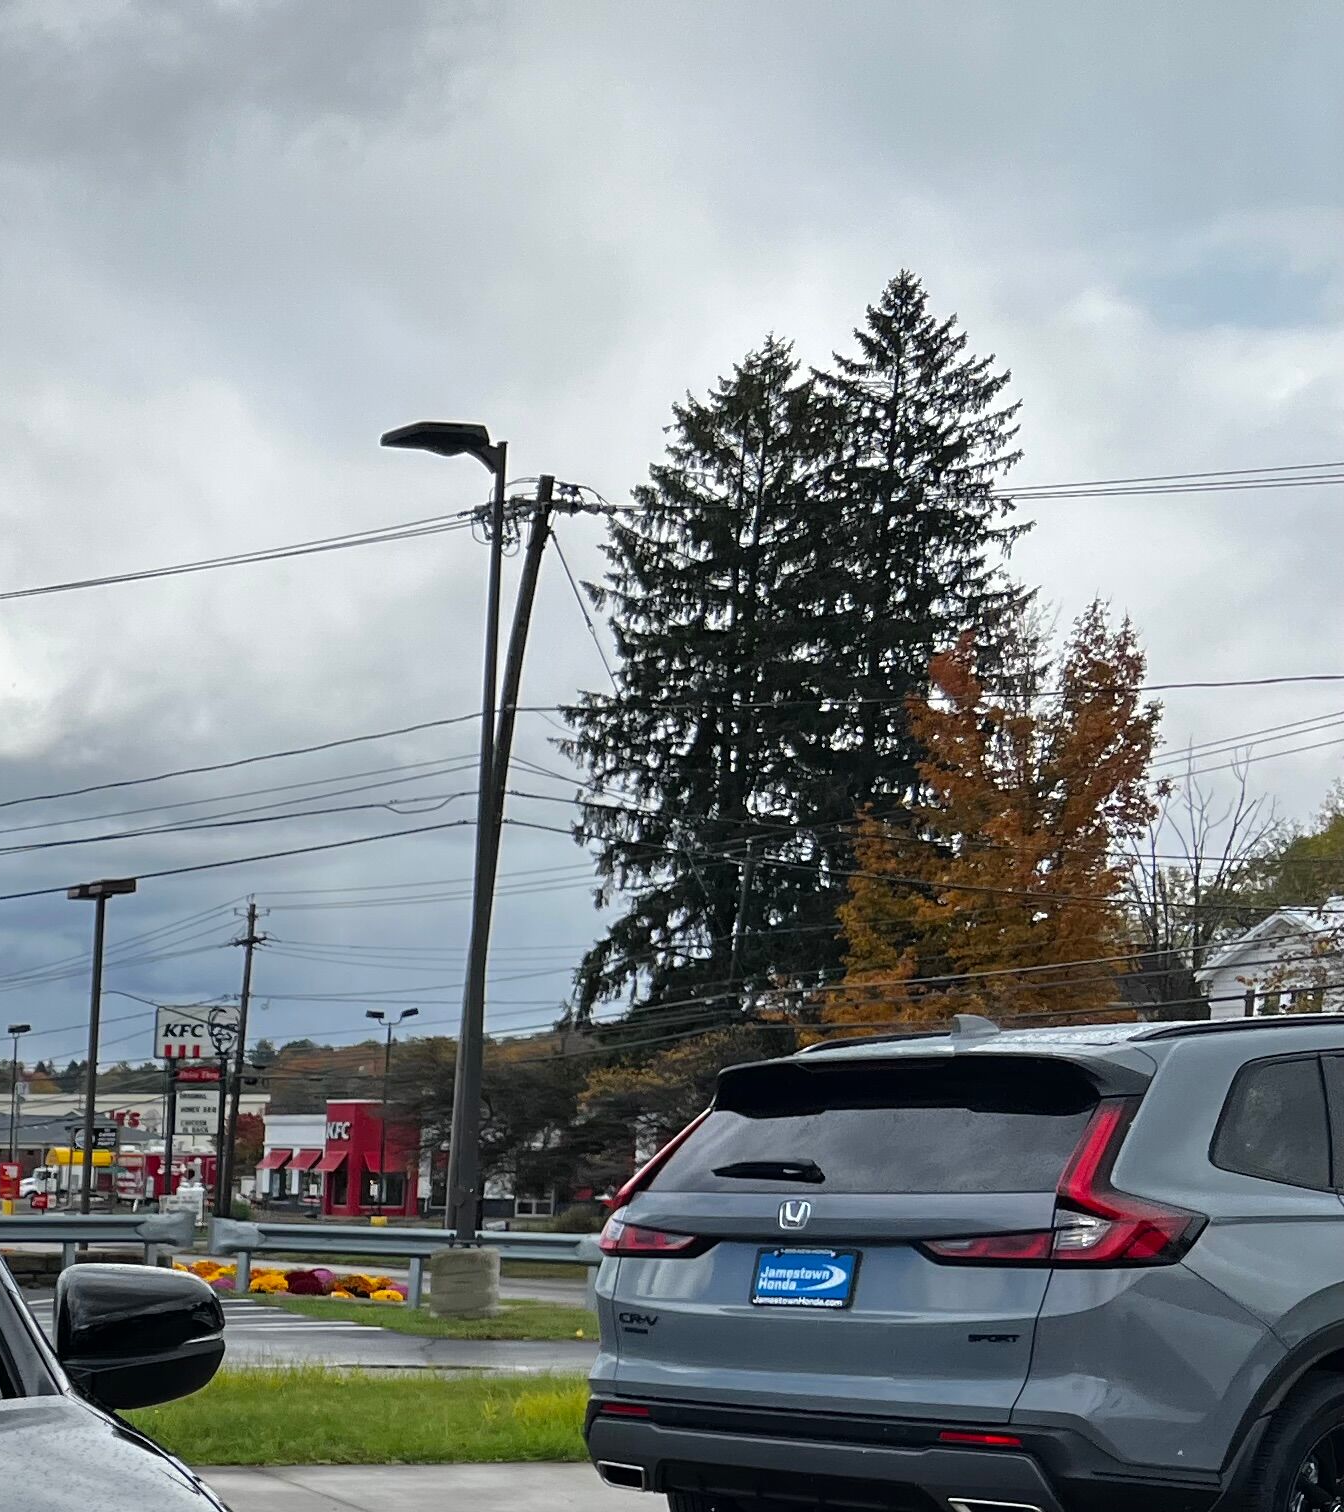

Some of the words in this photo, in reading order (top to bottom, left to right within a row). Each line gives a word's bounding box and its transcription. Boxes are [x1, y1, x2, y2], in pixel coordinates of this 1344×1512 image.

[162, 1023, 205, 1038] KFC
[326, 1121, 351, 1140] KFC
[760, 1266, 830, 1280] Jamestown
[758, 1278, 797, 1291] Honda
